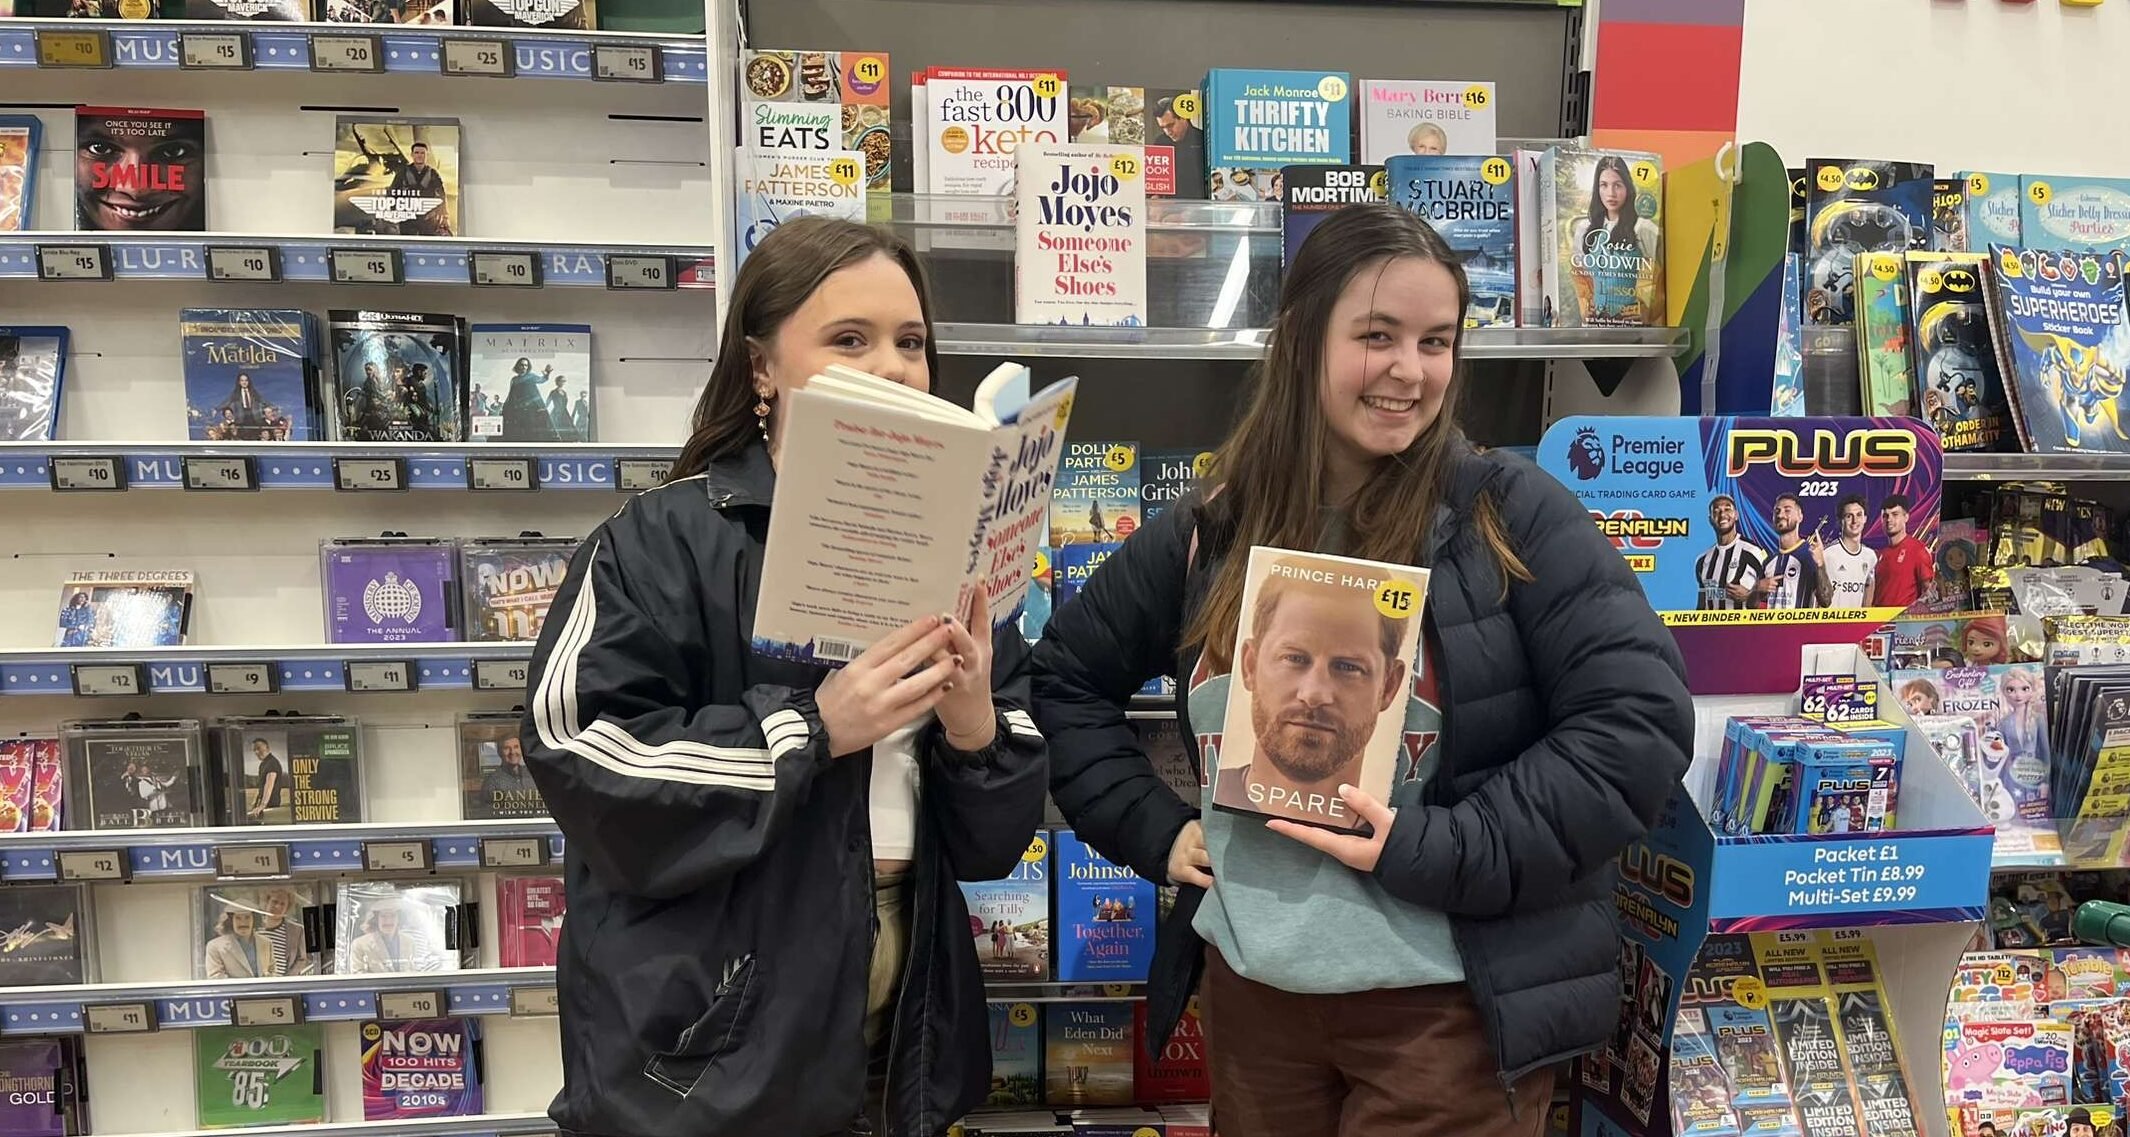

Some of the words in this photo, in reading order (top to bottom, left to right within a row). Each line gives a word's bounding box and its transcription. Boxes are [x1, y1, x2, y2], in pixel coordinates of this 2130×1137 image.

[217, 45, 235, 58] £15
[346, 48, 368, 62] £20
[478, 52, 498, 66] £25
[862, 64, 879, 77] £11
[1038, 80, 1056, 92] £11
[1244, 84, 1269, 97] Jack
[1274, 86, 1319, 99] Monroe
[954, 86, 984, 101] the
[1372, 88, 1417, 105] Mary
[1466, 92, 1486, 104] £16
[940, 98, 992, 122] fast
[996, 84, 1057, 123] 800
[1180, 99, 1195, 113] £8
[754, 104, 834, 131] Slimming
[1234, 100, 1329, 127] THRIFTY
[1387, 108, 1433, 120] BAKING
[1437, 109, 1472, 120] BIBLE
[105, 121, 128, 129] ONCE
[130, 121, 148, 129] YOU
[149, 122, 163, 130] SEE
[164, 122, 172, 130] IT
[110, 128, 125, 136] IT'S
[126, 128, 146, 137] TOO
[148, 128, 167, 137] LATE
[760, 127, 830, 150] EATS
[971, 124, 1058, 155] keto
[1234, 127, 1330, 153] KITCHEN
[770, 164, 830, 180] JAMES
[836, 164, 855, 179] £11
[1114, 160, 1136, 175] £12
[1487, 164, 1505, 178] £11
[1637, 167, 1649, 181] £7
[92, 162, 186, 192] SMILE
[1051, 165, 1120, 202] Jojo
[1325, 171, 1366, 187] BOB
[1820, 174, 1841, 184] £4.50
[1970, 178, 1982, 190] £5
[745, 180, 859, 199] PATTERSON
[1408, 180, 1495, 201] STUART
[2033, 187, 2044, 199] £5
[372, 200, 396, 214] TOP
[396, 200, 424, 214] GUN
[776, 199, 804, 207] MAXINE
[806, 200, 835, 208] PAETRO
[1038, 196, 1133, 232] Moyes
[2048, 203, 2076, 218] Sticker
[2078, 204, 2101, 222] Dolly
[2070, 221, 2115, 235] Parties
[1038, 231, 1132, 252] Someone
[1585, 229, 1634, 257] Rosie
[76, 258, 94, 270] £15
[244, 258, 263, 271] £10
[1058, 253, 1113, 274] Else's
[1570, 254, 1653, 272] GOODWIN
[1874, 264, 1895, 274] £4.50
[642, 268, 660, 280] £10
[1055, 275, 1117, 296] Shoes
[2030, 285, 2051, 296] Build
[2052, 288, 2069, 298] your
[2072, 290, 2092, 299] own
[2011, 294, 2121, 325] SUPERHEROES
[2042, 322, 2070, 334] Sticker
[2072, 324, 2094, 336] Book
[486, 338, 577, 348] MATRIX
[206, 346, 278, 365] Matilda
[369, 430, 433, 442] WAKANDA
[1612, 434, 1685, 456] Premier
[1111, 452, 1125, 465] £5
[1727, 429, 1917, 478] PLUS
[88, 468, 108, 481] £10
[221, 468, 240, 481] £16
[1612, 456, 1685, 480] League
[370, 469, 391, 482] £25
[1072, 475, 1119, 486] JAMES
[1054, 488, 1138, 499] PATTERSON
[1598, 490, 1639, 499] TRADING
[1642, 490, 1667, 498] CARD
[1669, 490, 1696, 498] GAME
[1798, 481, 1839, 497] 2023
[72, 572, 94, 581] THE
[98, 571, 135, 581] THREE
[138, 570, 189, 581] DEGREES
[489, 559, 567, 595] NOW
[1271, 564, 1335, 585] PRINCE
[1381, 590, 1412, 611] £15
[1674, 614, 1700, 623] NEW
[1702, 613, 1741, 622] BINDER
[1749, 612, 1775, 621] NEW
[1777, 611, 1816, 621] GOLDEN
[1817, 610, 1868, 620] BALLERS
[112, 676, 131, 687] £12
[246, 673, 259, 684] £9
[384, 672, 399, 682] £11
[508, 670, 526, 681] £13
[1803, 695, 1825, 713] 62
[1943, 698, 2000, 713] FROZEN
[1826, 704, 1850, 722] 62
[292, 758, 319, 775] ONLY
[1876, 768, 1888, 780] 7
[294, 774, 311, 790] THE
[1818, 780, 1872, 791] PLUS
[294, 790, 338, 805] STRONG
[1247, 783, 1346, 818] SPARE
[296, 805, 339, 821] SURVIVE
[402, 851, 415, 862] £5
[1814, 846, 1876, 864] Packet
[1879, 846, 1899, 860] £1
[94, 860, 113, 871] £12
[1784, 868, 1846, 886] Pocket
[1850, 867, 1877, 883] Tin
[1880, 865, 1925, 882] £8.99
[974, 890, 1031, 904] Searching
[1788, 888, 1869, 907] Multi-Set
[1872, 886, 1917, 903] £9.99
[979, 904, 995, 915] for
[998, 904, 1025, 916] Tilly
[1072, 923, 1145, 939] Together,
[1779, 933, 1806, 943] £5.99
[1084, 942, 1129, 957] Again
[1765, 949, 1783, 958] ALL
[1784, 948, 1806, 957] NEW
[1996, 970, 2011, 978] 112
[412, 1001, 431, 1011] £10
[1014, 1010, 1028, 1021] £5
[1072, 1011, 1105, 1024] What
[1064, 1028, 1096, 1040] Eden
[1100, 1027, 1124, 1040] Did
[1717, 1025, 1766, 1038] PLUS
[1964, 1028, 1990, 1038] Magic
[1991, 1027, 2012, 1036] Slate
[2045, 1032, 2057, 1041] 20
[381, 1031, 461, 1056] NOW
[1083, 1044, 1113, 1057] Next
[1788, 1039, 1835, 1051] LIMITED
[387, 1058, 418, 1067] 100
[424, 1057, 457, 1067] HITS
[1790, 1050, 1838, 1062] EDITION
[2006, 1050, 2044, 1071] Peppa
[2046, 1050, 2065, 1069] Pig
[381, 1072, 465, 1091] DECADE
[402, 1094, 446, 1107] 2010s
[1862, 1098, 1908, 1110] LIMITED
[1804, 1106, 1852, 1118] LIMITED
[1866, 1108, 1911, 1120] EDITION
[1807, 1116, 1855, 1128] EDITION
